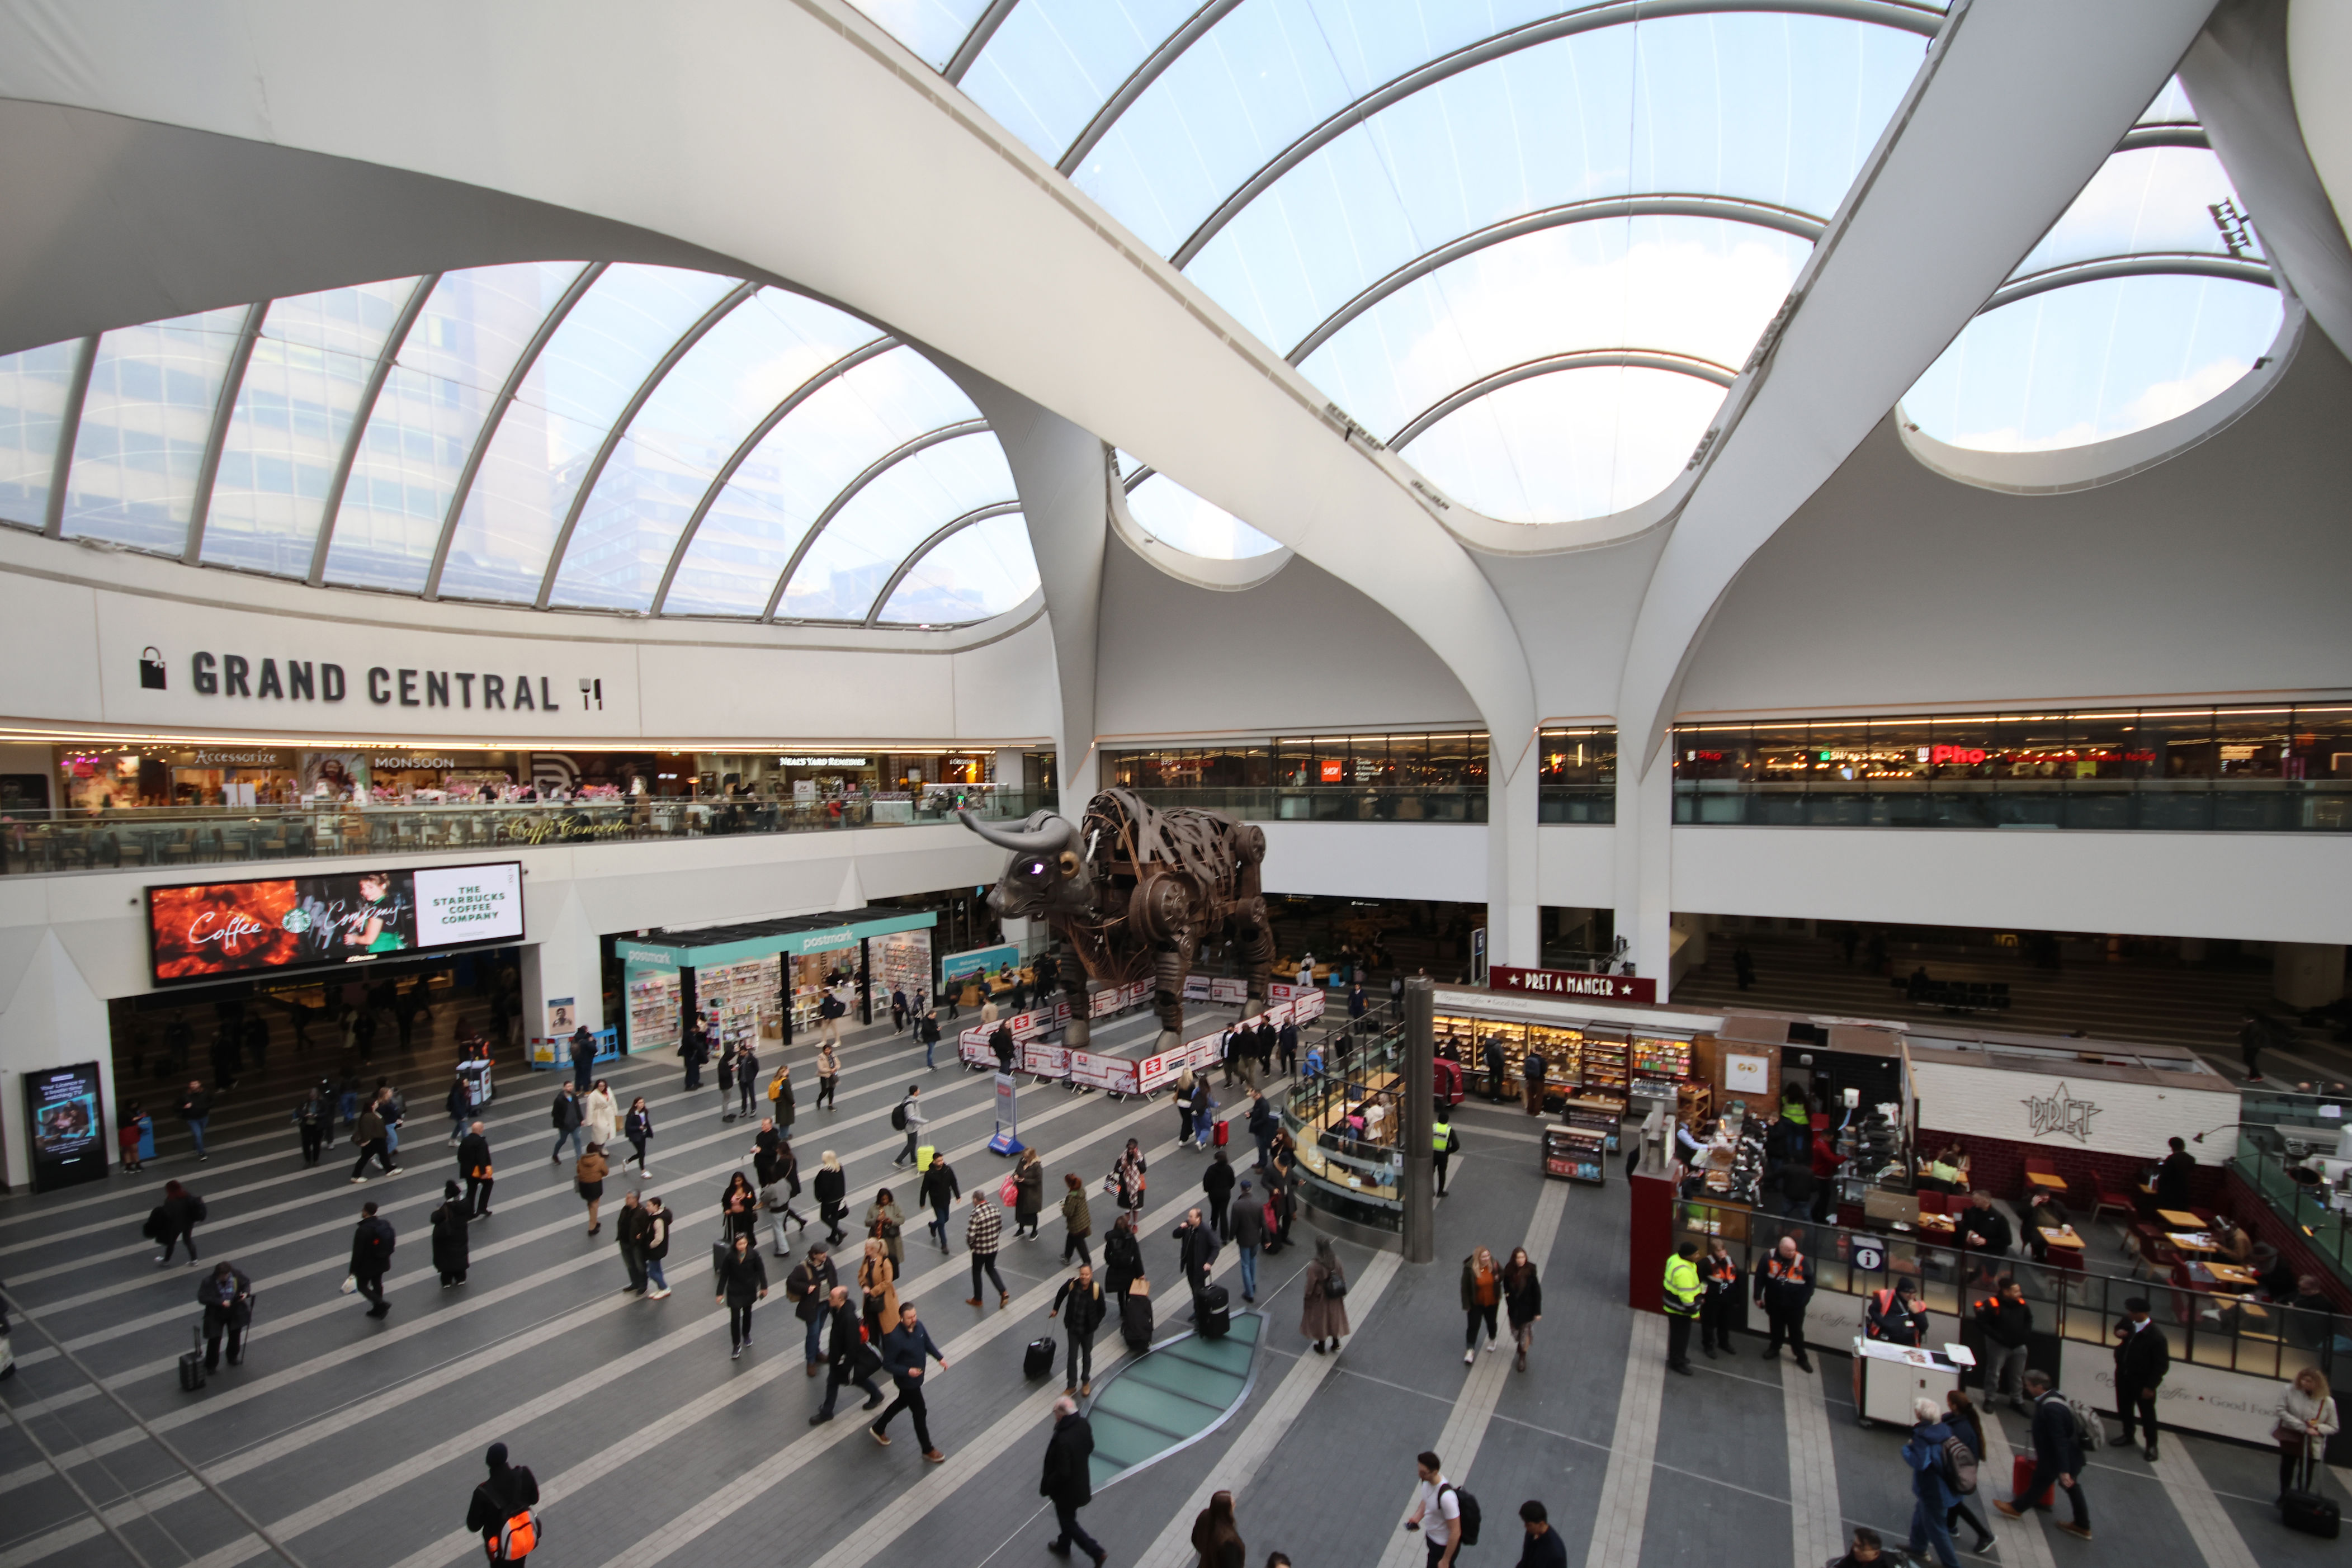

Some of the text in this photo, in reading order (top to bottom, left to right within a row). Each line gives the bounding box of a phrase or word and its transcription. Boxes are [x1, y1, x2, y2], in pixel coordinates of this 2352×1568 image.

[192, 651, 559, 711] GRAND CENTRAL
[194, 749, 277, 764] Accessorize
[806, 757, 828, 766] YARD
[828, 757, 866, 766] REMEDIES
[1933, 745, 1986, 764] Pho
[374, 757, 455, 769] MONSOON
[558, 815, 629, 838] Concerto
[458, 885, 481, 895] THE
[432, 892, 506, 906] STARBUCKS
[957, 900, 965, 912] 4
[323, 898, 400, 933] Company
[448, 903, 493, 914] COFFEE
[441, 911, 499, 924] COMPANY
[188, 910, 263, 950] Coffee
[803, 929, 853, 951] postmark
[1478, 934, 1483, 948] 6
[628, 950, 671, 965] postmark
[1525, 972, 1614, 996] PRET A MANGER
[2030, 1095, 2095, 1136] PRET
[2209, 1396, 2246, 1412] Good
[2251, 1404, 2279, 1417] Foo
